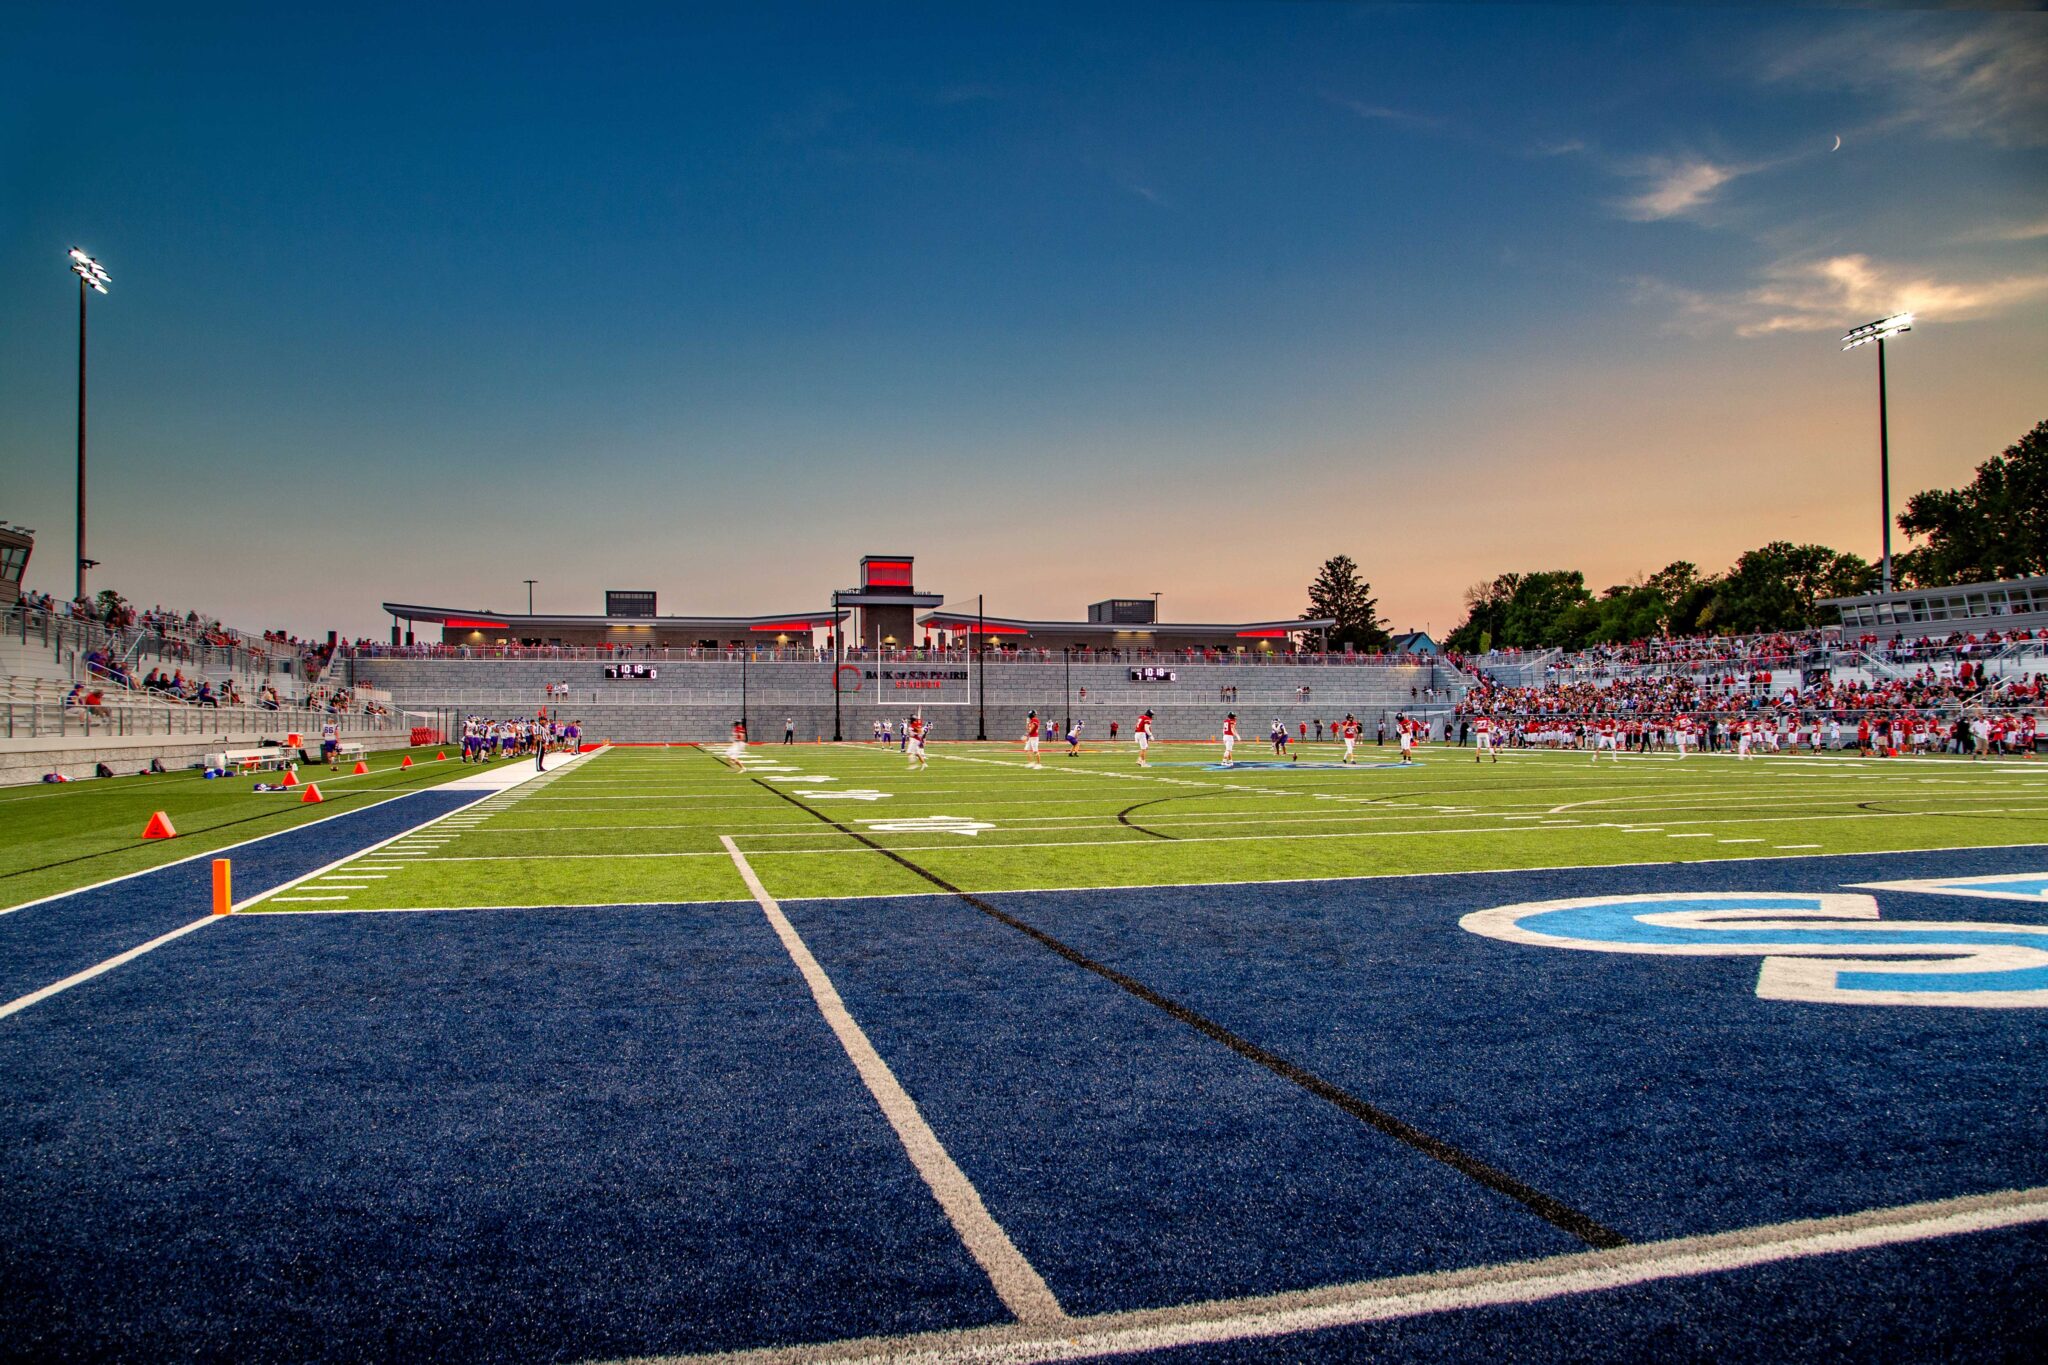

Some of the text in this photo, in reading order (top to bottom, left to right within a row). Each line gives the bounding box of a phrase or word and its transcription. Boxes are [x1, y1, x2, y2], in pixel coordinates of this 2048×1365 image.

[650, 669, 657, 679] 0
[865, 671, 893, 680] BANK
[909, 671, 928, 680] SUN
[930, 671, 969, 680] PRAIRIE
[895, 681, 941, 689] STADIUM
[324, 726, 334, 734] 66
